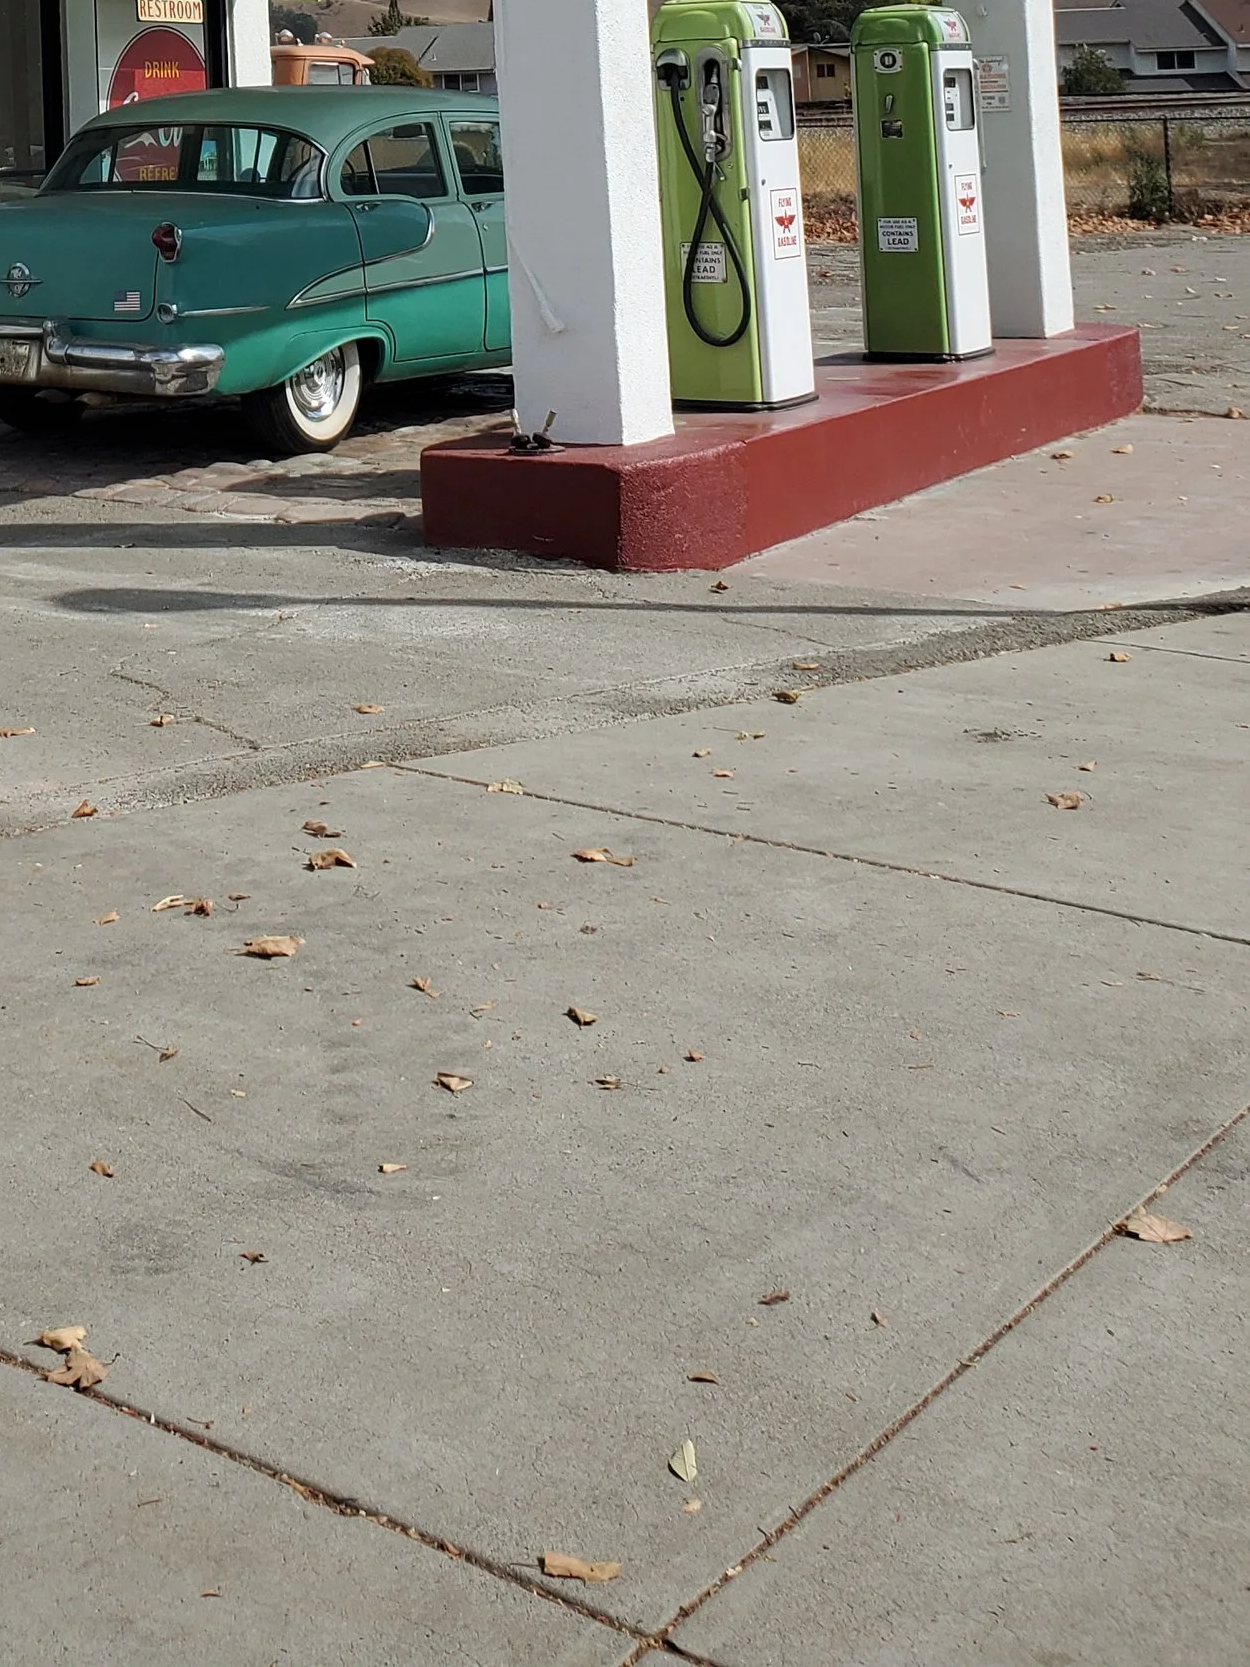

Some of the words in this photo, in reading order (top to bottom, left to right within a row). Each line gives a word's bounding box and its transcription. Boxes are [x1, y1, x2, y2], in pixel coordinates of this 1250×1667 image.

[144, 60, 180, 79] DRINK
[139, 165, 177, 182] REFRE
[887, 238, 910, 246] LEAD
